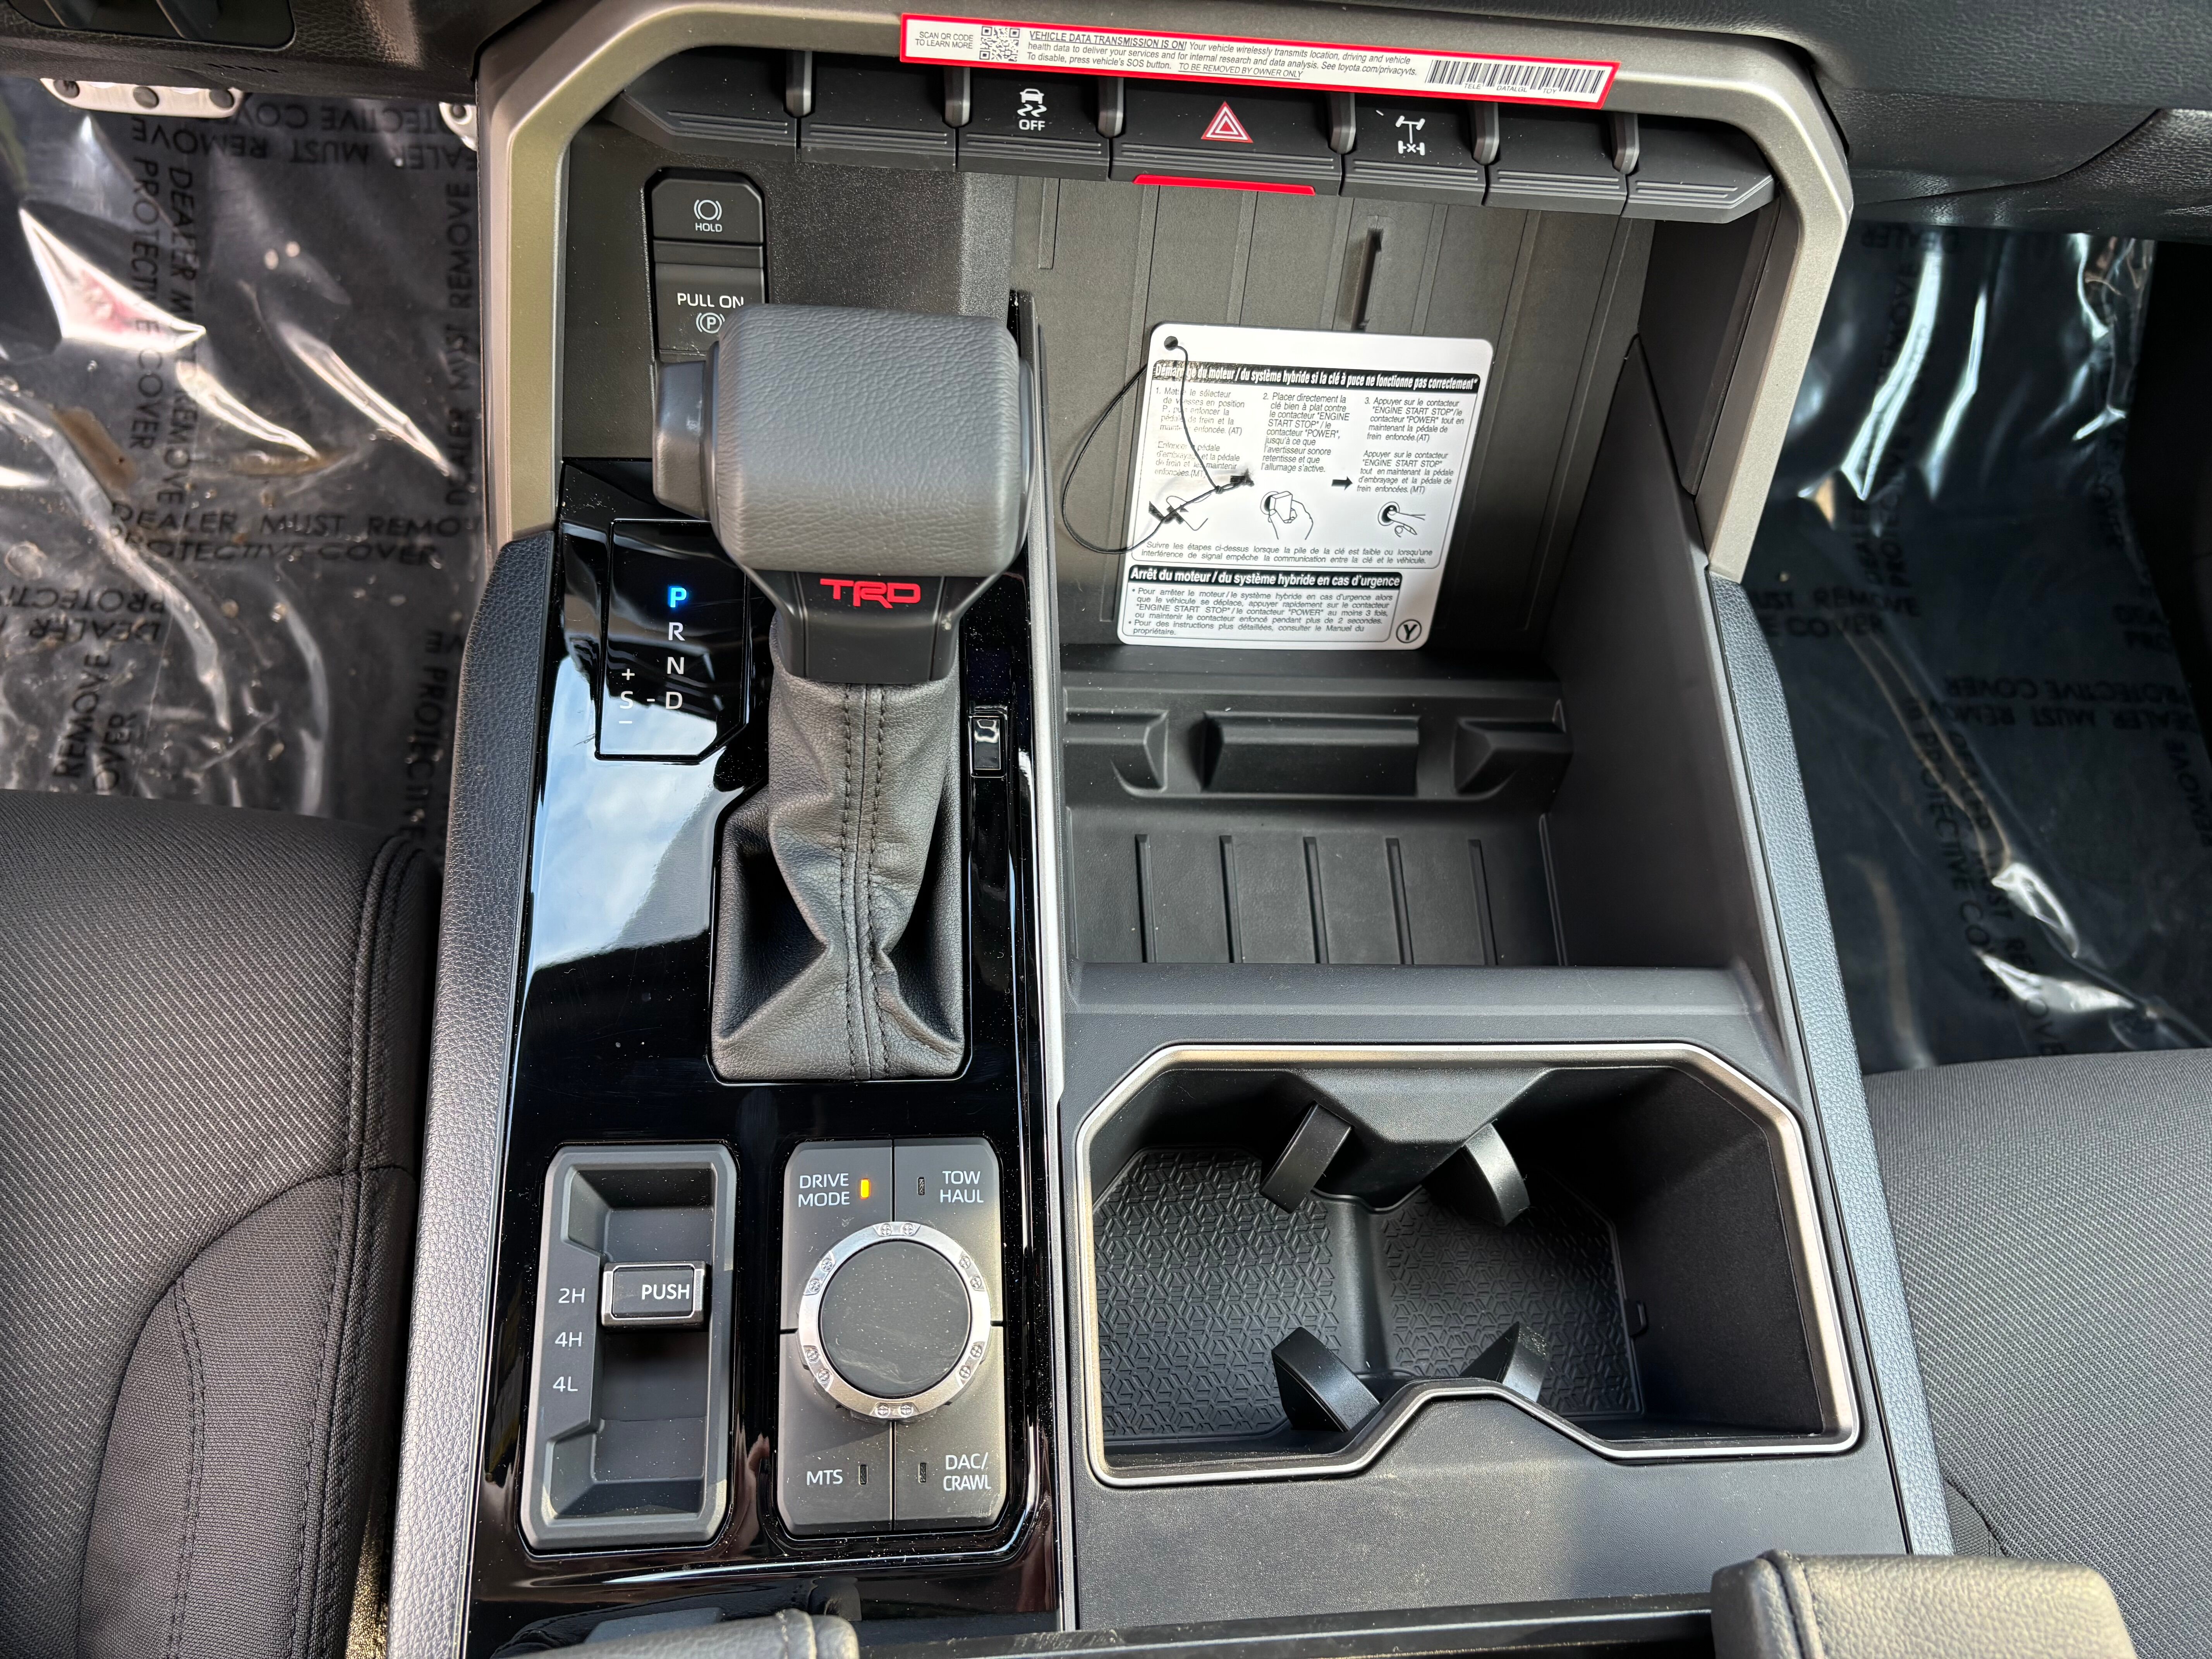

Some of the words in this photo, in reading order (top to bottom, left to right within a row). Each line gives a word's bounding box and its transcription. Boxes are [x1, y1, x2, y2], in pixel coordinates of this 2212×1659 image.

[1029, 31, 1066, 41] VEHICLE
[1070, 33, 1091, 43] DATA
[1094, 35, 1159, 48] TRANSMISSION
[1162, 40, 1169, 49] IS
[1190, 41, 1206, 50] Your
[1208, 43, 1233, 52] vehicle
[1237, 45, 1273, 57] wirelessly
[1274, 48, 1307, 58] transmits
[1310, 50, 1340, 61] location,
[1343, 53, 1367, 63] driving
[1369, 55, 1383, 63] and
[1386, 56, 1410, 64] vehicle
[1027, 52, 1036, 60] To
[1038, 53, 1066, 64] disable,
[1070, 57, 1089, 65] press
[1092, 57, 1124, 66] vehicle's
[1127, 59, 1144, 67] SOS
[1147, 61, 1171, 70] button.
[1203, 65, 1240, 74] REMOVED
[1028, 42, 1051, 51] health
[1053, 44, 1070, 52] data
[1083, 46, 1107, 55] deliver
[1110, 49, 1126, 57] your
[1161, 51, 1175, 60] and
[1190, 52, 1216, 62] internal
[1219, 55, 1251, 65] research
[1287, 60, 1318, 69] analysis.
[1321, 62, 1336, 70] See
[1019, 119, 1045, 131] OFF
[132, 117, 267, 159] REMOVE
[290, 139, 368, 165] MUST
[695, 222, 722, 232] HOLD
[445, 183, 473, 308] REMOVE
[677, 293, 714, 307] PULL
[719, 295, 744, 309] ON
[1198, 366, 1208, 378] du
[1241, 369, 1250, 380] du
[1251, 369, 1281, 383] système
[1283, 370, 1310, 385] hybride
[1311, 372, 1319, 384] si
[1319, 372, 1328, 384] la
[1328, 372, 1340, 385] clé
[1346, 376, 1364, 388] puce
[1365, 378, 1375, 386] ne
[1376, 375, 1413, 388] fonctionne
[1413, 378, 1427, 390] pas
[129, 348, 163, 450] COVER
[1272, 392, 1295, 400] Placer
[1297, 393, 1338, 403] directement
[1374, 397, 1402, 406] Appuyer
[1427, 398, 1459, 407] contacteur
[1309, 404, 1322, 412] plat
[1268, 419, 1293, 427] START
[1416, 425, 1438, 434] pédale
[1264, 445, 1306, 454] l'avertisseur
[1265, 436, 1290, 445] jusqu'à
[1303, 439, 1316, 447] que
[1261, 462, 1296, 473] l'allumage
[112, 502, 238, 534] DEALER
[259, 514, 346, 535] MUST
[1131, 567, 1157, 580] Arrêt
[1159, 569, 1172, 581] du
[1174, 571, 1211, 582] moteur
[1218, 572, 1232, 583] du
[1234, 571, 1276, 587] système
[1278, 573, 1316, 587] hybride
[1317, 577, 1329, 586] en
[1332, 577, 1349, 586] cas
[1352, 575, 1400, 589] d'urgence
[669, 586, 687, 608] P
[820, 579, 921, 608] TRD
[668, 622, 685, 641] R
[1403, 624, 1418, 641] Y
[667, 657, 684, 674] N
[620, 691, 633, 709] S
[665, 691, 683, 709] D
[799, 1173, 849, 1188] DRIVE
[942, 1170, 981, 1184] TOW
[798, 1191, 850, 1207] MODE
[940, 1189, 984, 1203] HAUL
[558, 1288, 585, 1303] 2H
[642, 1284, 690, 1300] PUSH
[555, 1331, 582, 1347] 4H
[553, 1376, 578, 1392] 4L
[946, 1452, 988, 1470] DAC/
[807, 1469, 843, 1486] MTS
[943, 1475, 991, 1491] CRAWL
